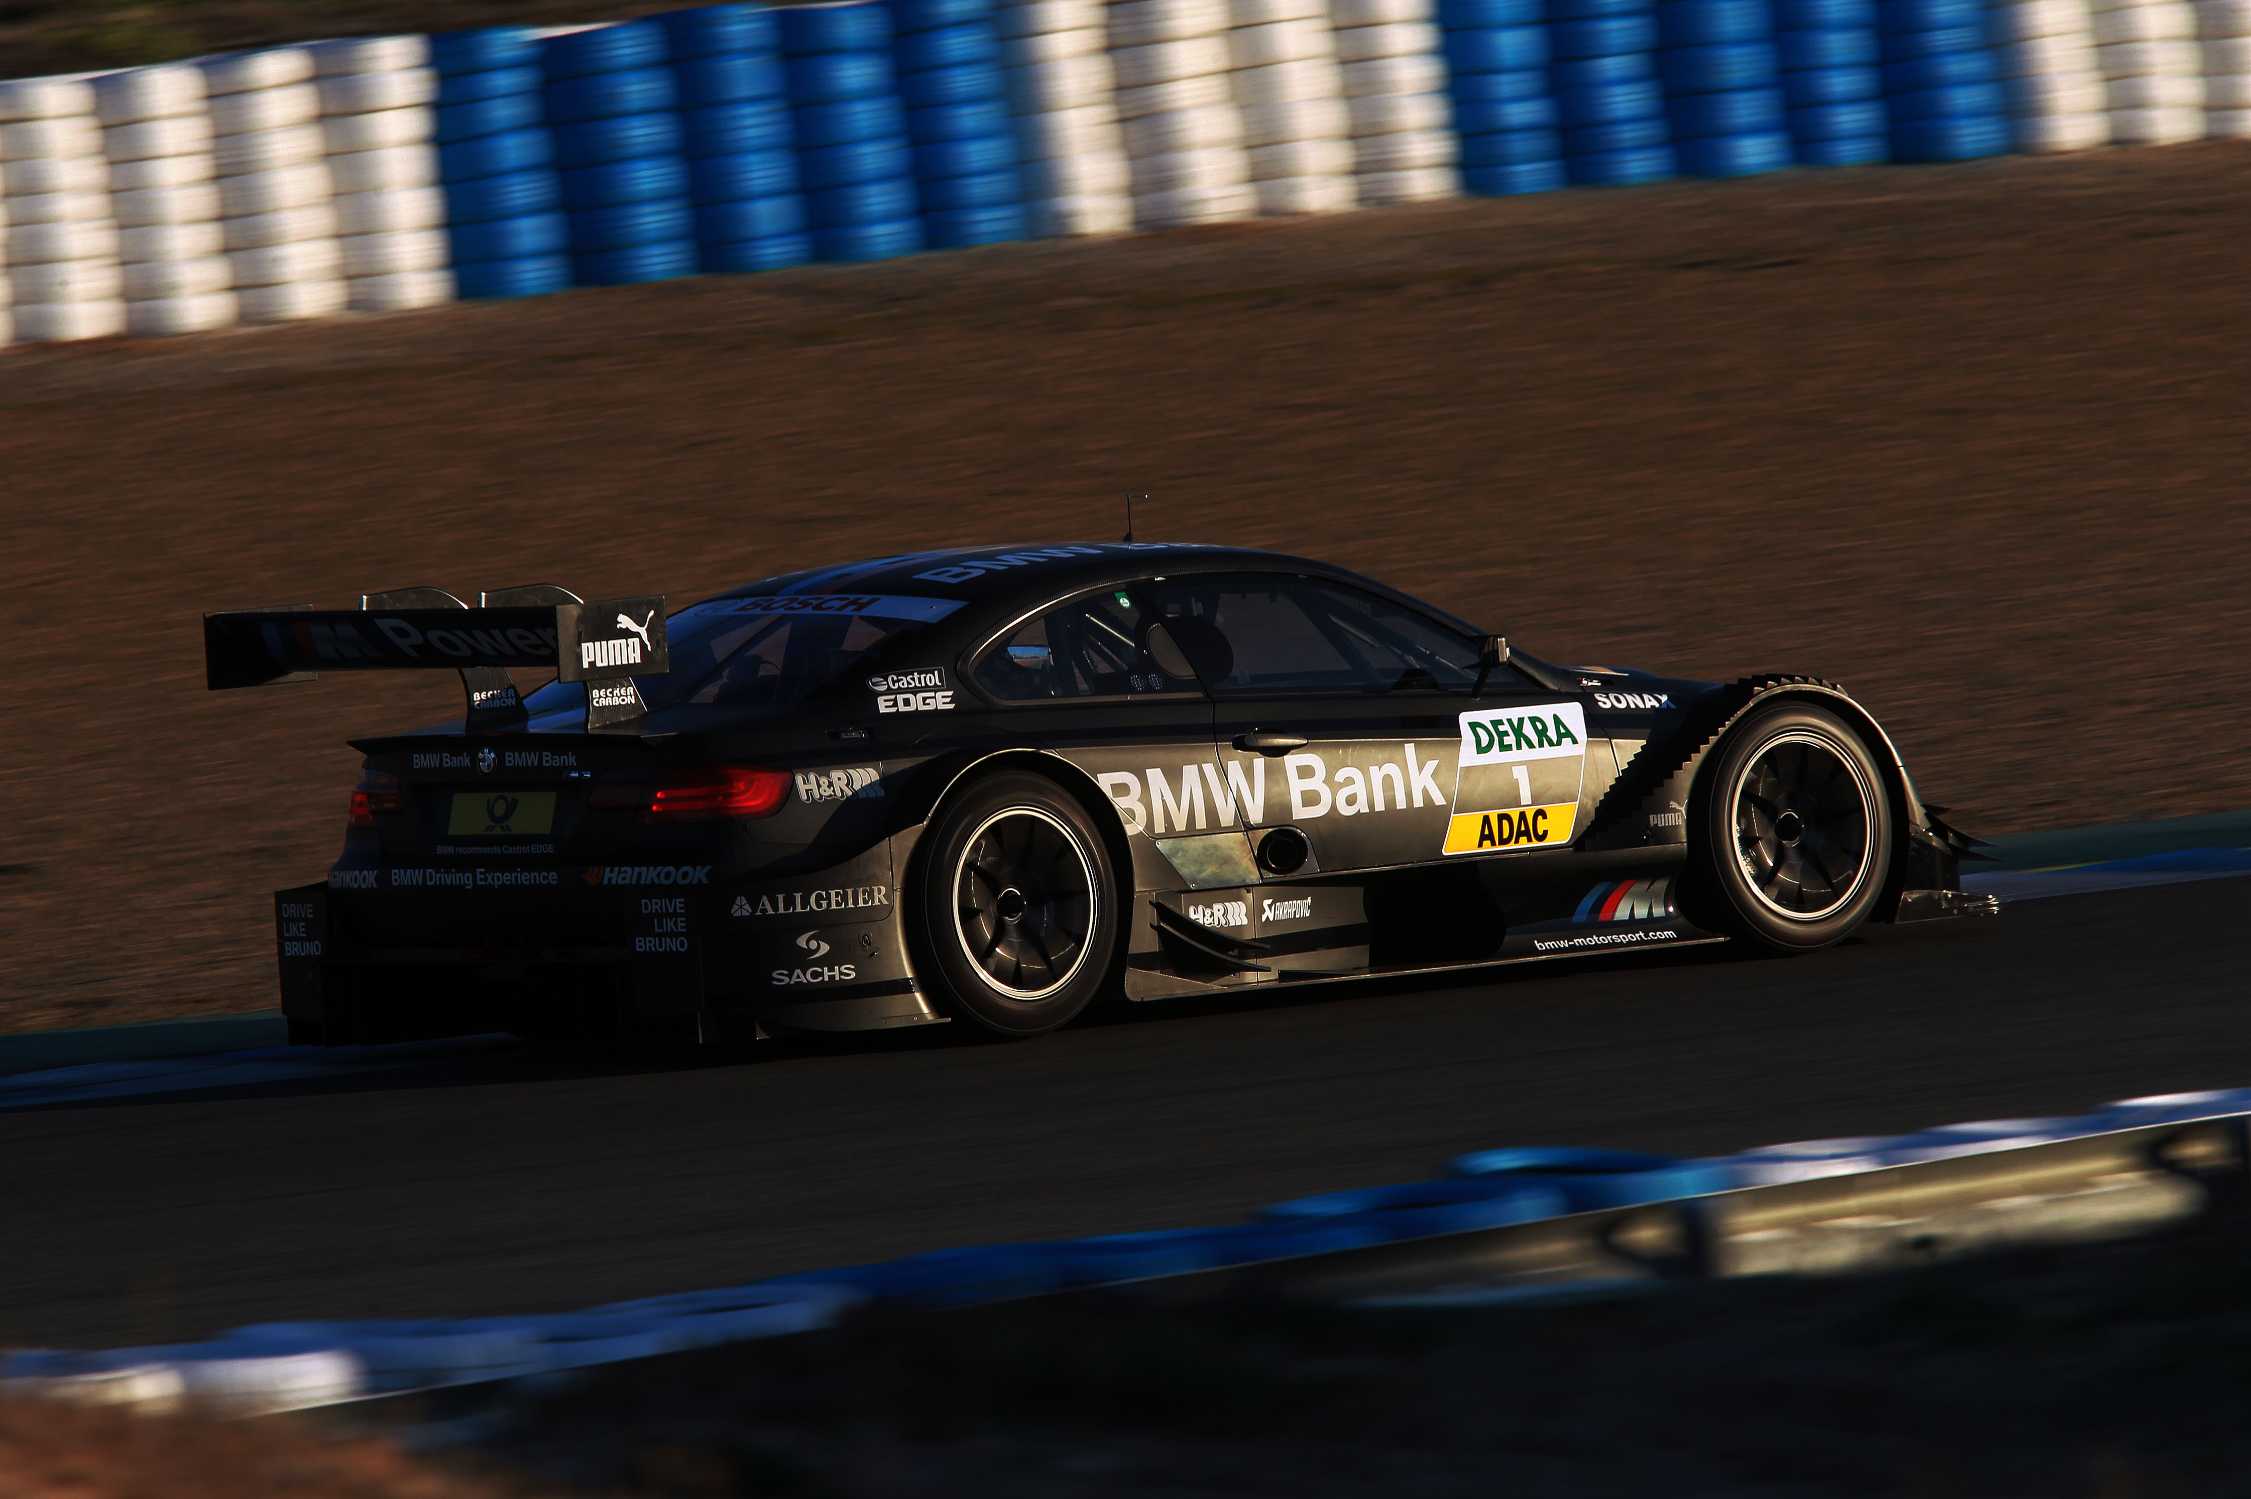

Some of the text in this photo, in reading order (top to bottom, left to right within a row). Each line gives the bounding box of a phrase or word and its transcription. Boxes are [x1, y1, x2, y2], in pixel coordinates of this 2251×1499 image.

[912, 546, 1103, 584] BMW
[736, 596, 880, 612] BOSCH
[581, 637, 641, 668] PUMA
[887, 670, 941, 690] Castrol
[473, 687, 516, 701] BECKER
[593, 685, 635, 698] BECKER
[593, 695, 636, 708] CARBON
[877, 691, 956, 714] EDGE
[1593, 692, 1678, 709] SONAX
[1467, 713, 1579, 755] DEKRA
[412, 752, 472, 768] BMW Bank
[504, 751, 577, 767] BMW Bank
[1097, 743, 1447, 836] BMW Bank
[1511, 765, 1532, 806] 1
[1477, 808, 1549, 848] ADAC
[1650, 812, 1682, 827] PUMA
[391, 867, 559, 889] BMW Driving Experience
[641, 898, 686, 915] DRIVE
[755, 885, 890, 916] ALLGEIER
[282, 904, 314, 919] DRIVE
[283, 922, 307, 937] LIKE
[653, 917, 688, 934] LIKE
[284, 940, 322, 957] BRUNO
[635, 936, 689, 953] BRUNO
[1534, 929, 1678, 951] bmw-motorsport.com
[771, 964, 857, 986] SACHS
